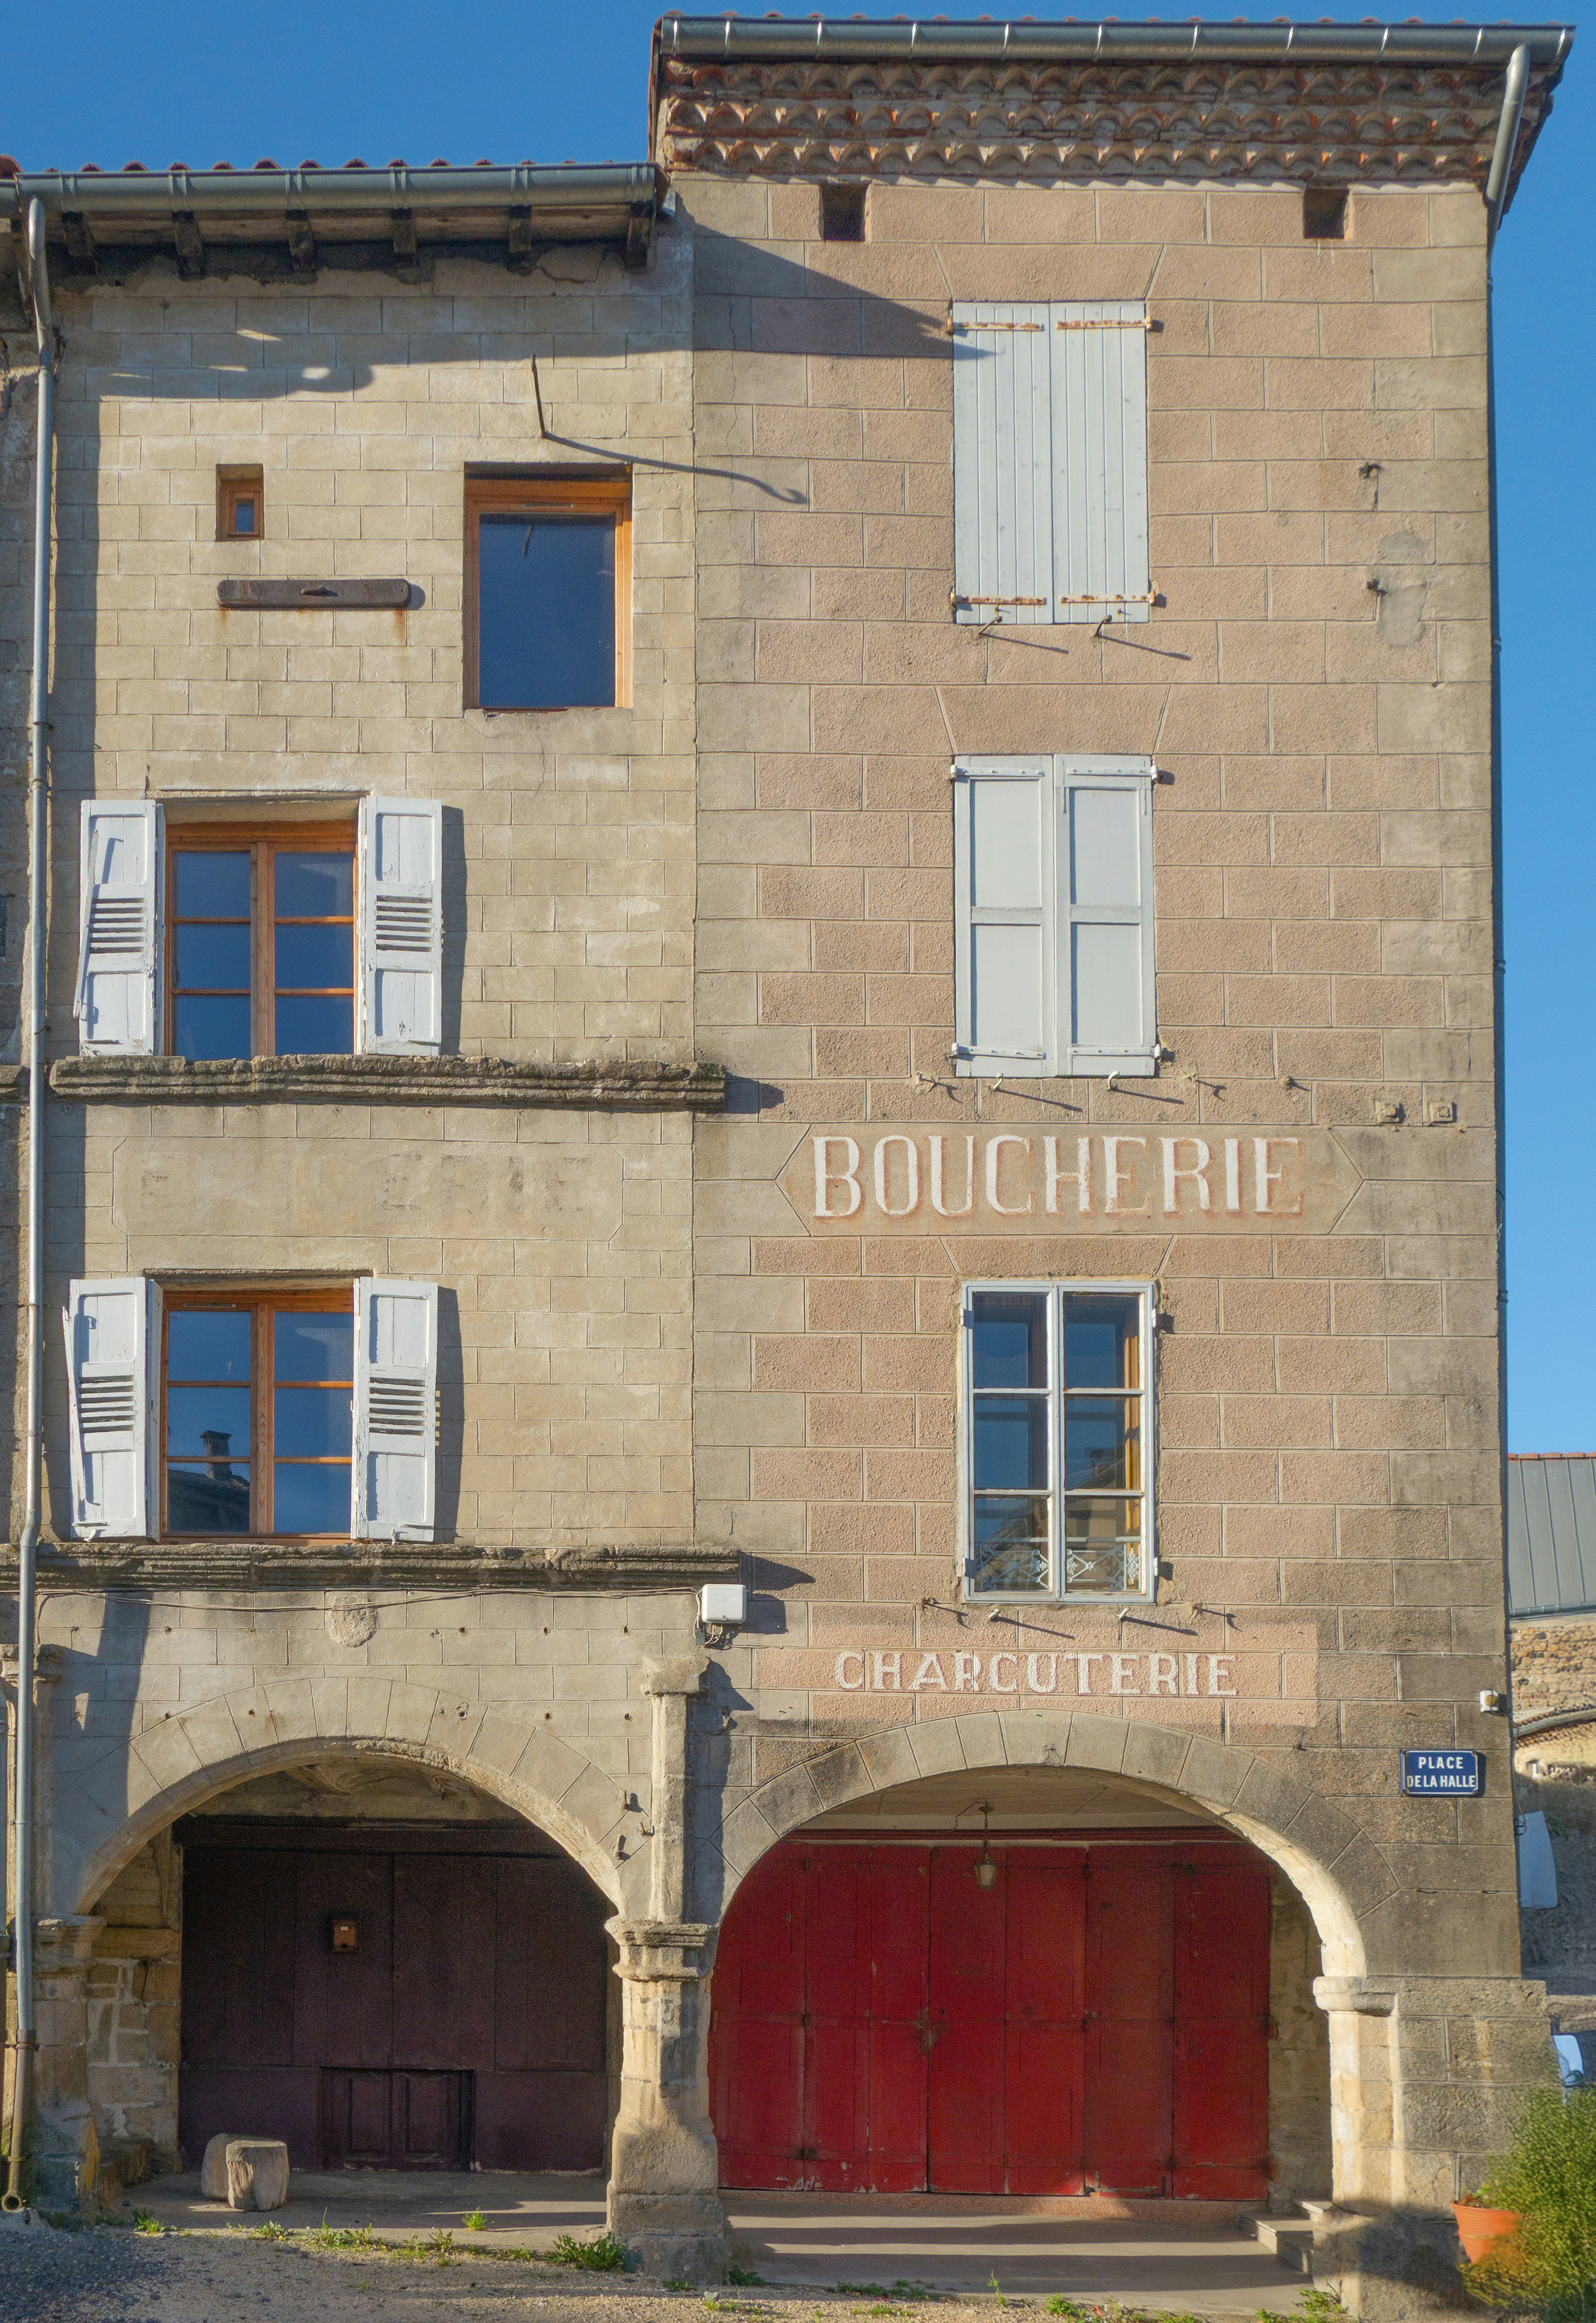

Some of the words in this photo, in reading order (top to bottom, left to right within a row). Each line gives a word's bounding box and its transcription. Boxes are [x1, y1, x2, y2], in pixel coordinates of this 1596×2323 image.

[811, 1134, 1303, 1218] BOUCHERIE
[833, 1650, 1238, 1697] CHARCUTERIE
[1418, 1756, 1464, 1769] PLACE
[1406, 1775, 1422, 1788] DE
[1423, 1775, 1438, 1788] LA
[1440, 1775, 1476, 1788] HALLE
